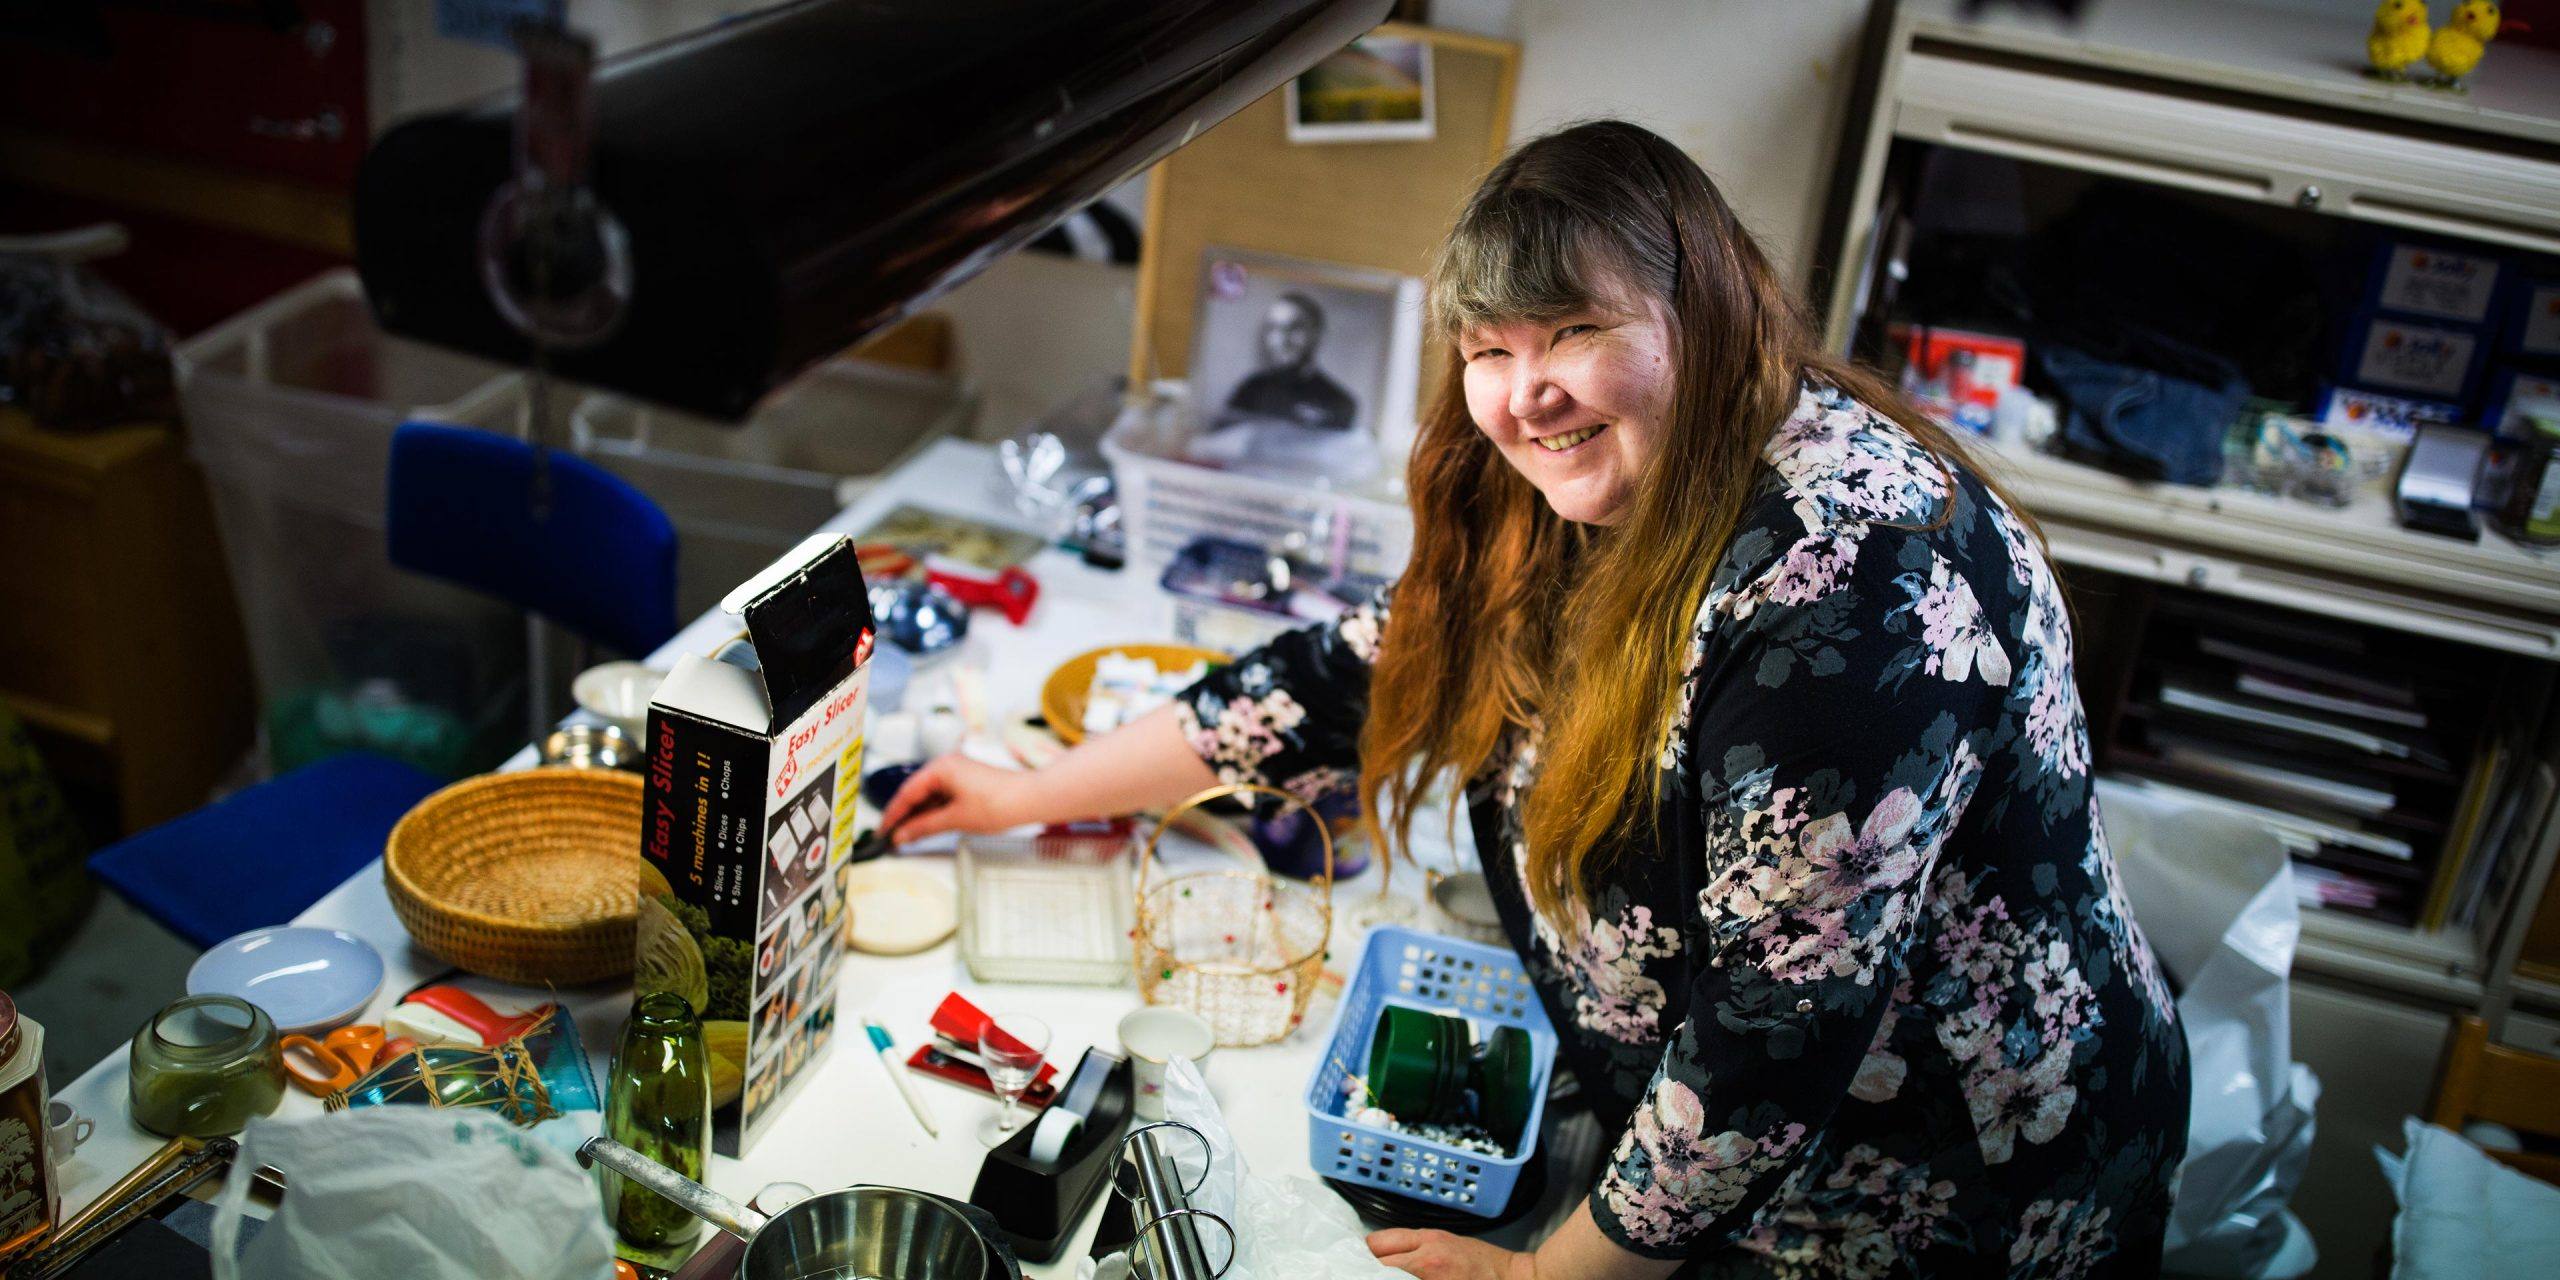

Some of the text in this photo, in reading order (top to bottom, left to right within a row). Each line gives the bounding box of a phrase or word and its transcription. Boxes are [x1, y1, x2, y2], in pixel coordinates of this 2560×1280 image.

[788, 720, 820, 755] Easy
[824, 687, 860, 726] Slicer
[650, 719, 676, 861] Easy Slicer
[689, 751, 711, 886] 5 machines in 1!
[718, 813, 729, 842] Dices
[732, 817, 747, 898] Shreds Chips
[714, 864, 726, 893] Slices
